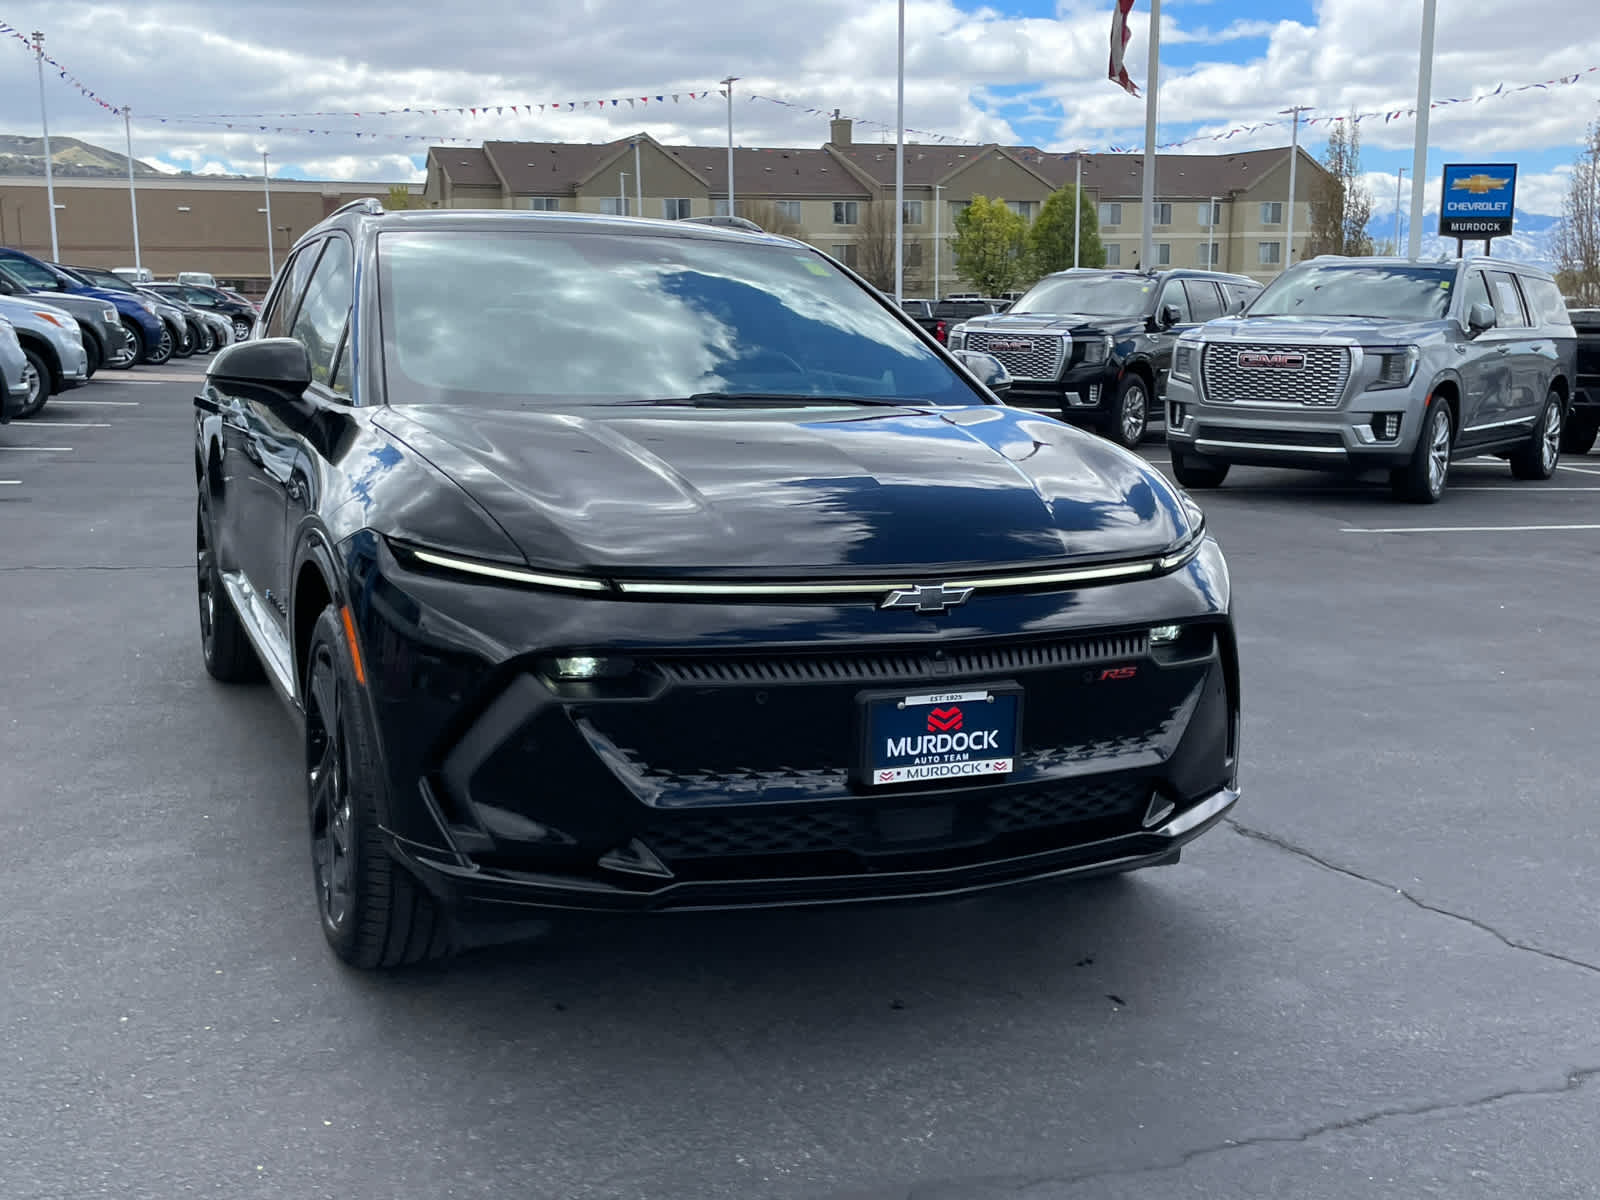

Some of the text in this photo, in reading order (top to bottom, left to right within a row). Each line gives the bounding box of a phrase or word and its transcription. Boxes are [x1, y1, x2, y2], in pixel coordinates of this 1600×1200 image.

[1447, 202, 1508, 211] CHEVROLET
[1451, 223, 1500, 231] MURDOCK
[1240, 354, 1303, 368] GMC
[1099, 666, 1136, 680] RS
[887, 730, 999, 758] MURDOCK
[914, 753, 969, 765] AUTO TEAM
[906, 763, 981, 779] MURDOCK
